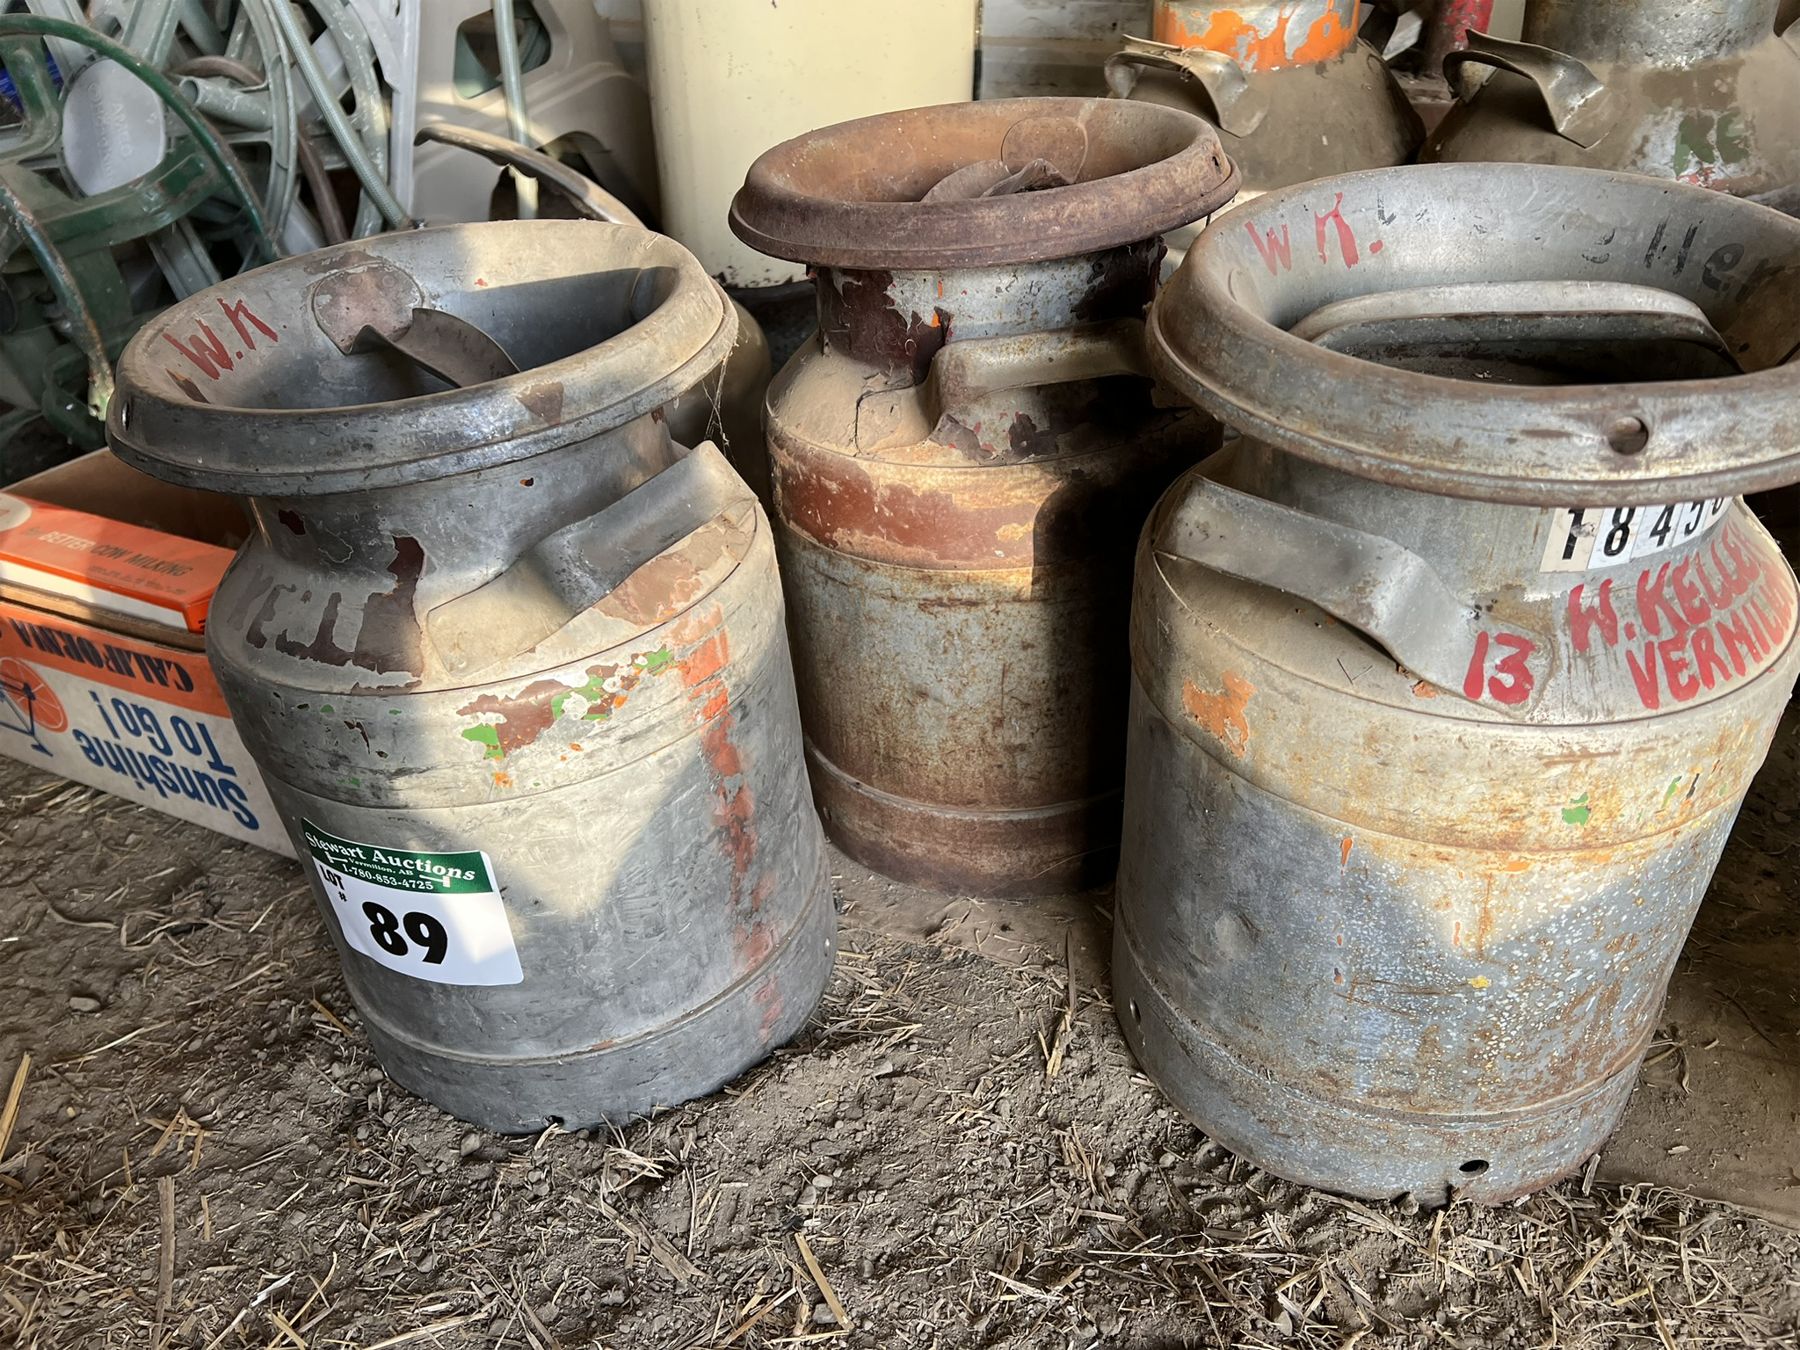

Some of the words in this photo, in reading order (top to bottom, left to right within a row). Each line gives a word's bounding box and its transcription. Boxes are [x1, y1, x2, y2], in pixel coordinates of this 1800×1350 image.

[37, 530, 97, 551] BETTER
[90, 544, 129, 562] COW
[123, 553, 193, 577] MILKING
[9, 618, 194, 694] CALIFORNIA
[1463, 630, 1536, 706] 13
[72, 728, 260, 831] Sunshine
[305, 832, 367, 860] Stewart
[372, 850, 476, 881] Auctions
[319, 864, 345, 890] LOT
[342, 863, 434, 890] 1-780-853-4725
[398, 868, 414, 876] AB
[362, 901, 448, 965] 89
